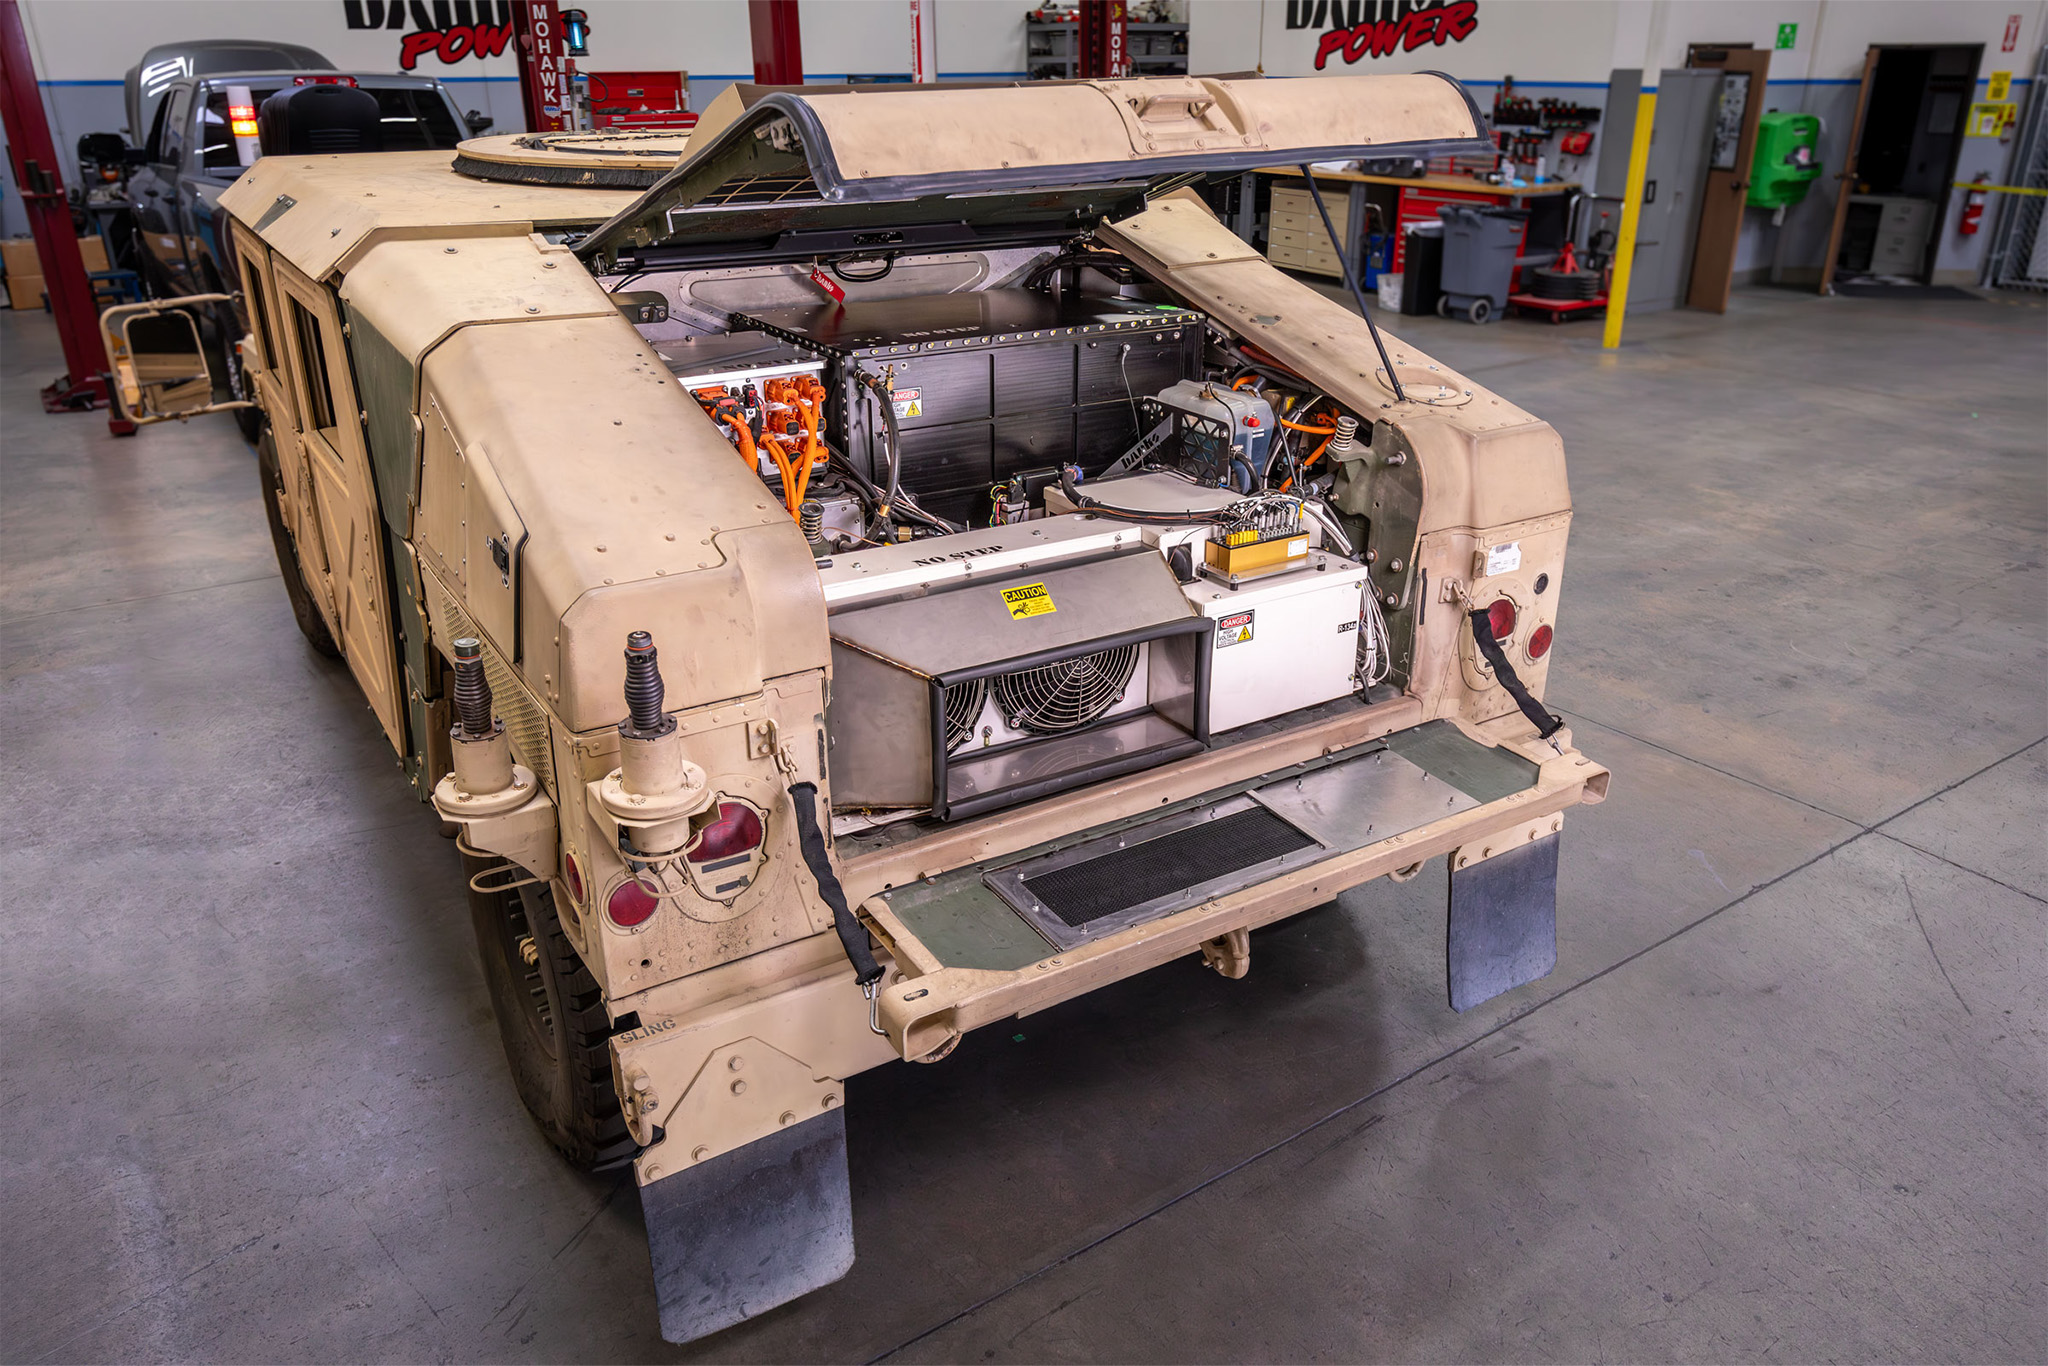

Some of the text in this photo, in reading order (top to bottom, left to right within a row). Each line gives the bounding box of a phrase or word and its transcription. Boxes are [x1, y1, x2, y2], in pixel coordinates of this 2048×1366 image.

[1314, 1, 1478, 70] POWER
[532, 4, 558, 103] MOHAWK
[1110, 22, 1121, 78] MOHA
[893, 391, 917, 400] ANGER
[912, 545, 1003, 567] NO STEP
[1005, 586, 1047, 601] CAUTION
[1224, 615, 1249, 628] DANGER
[620, 1019, 676, 1044] SLING
